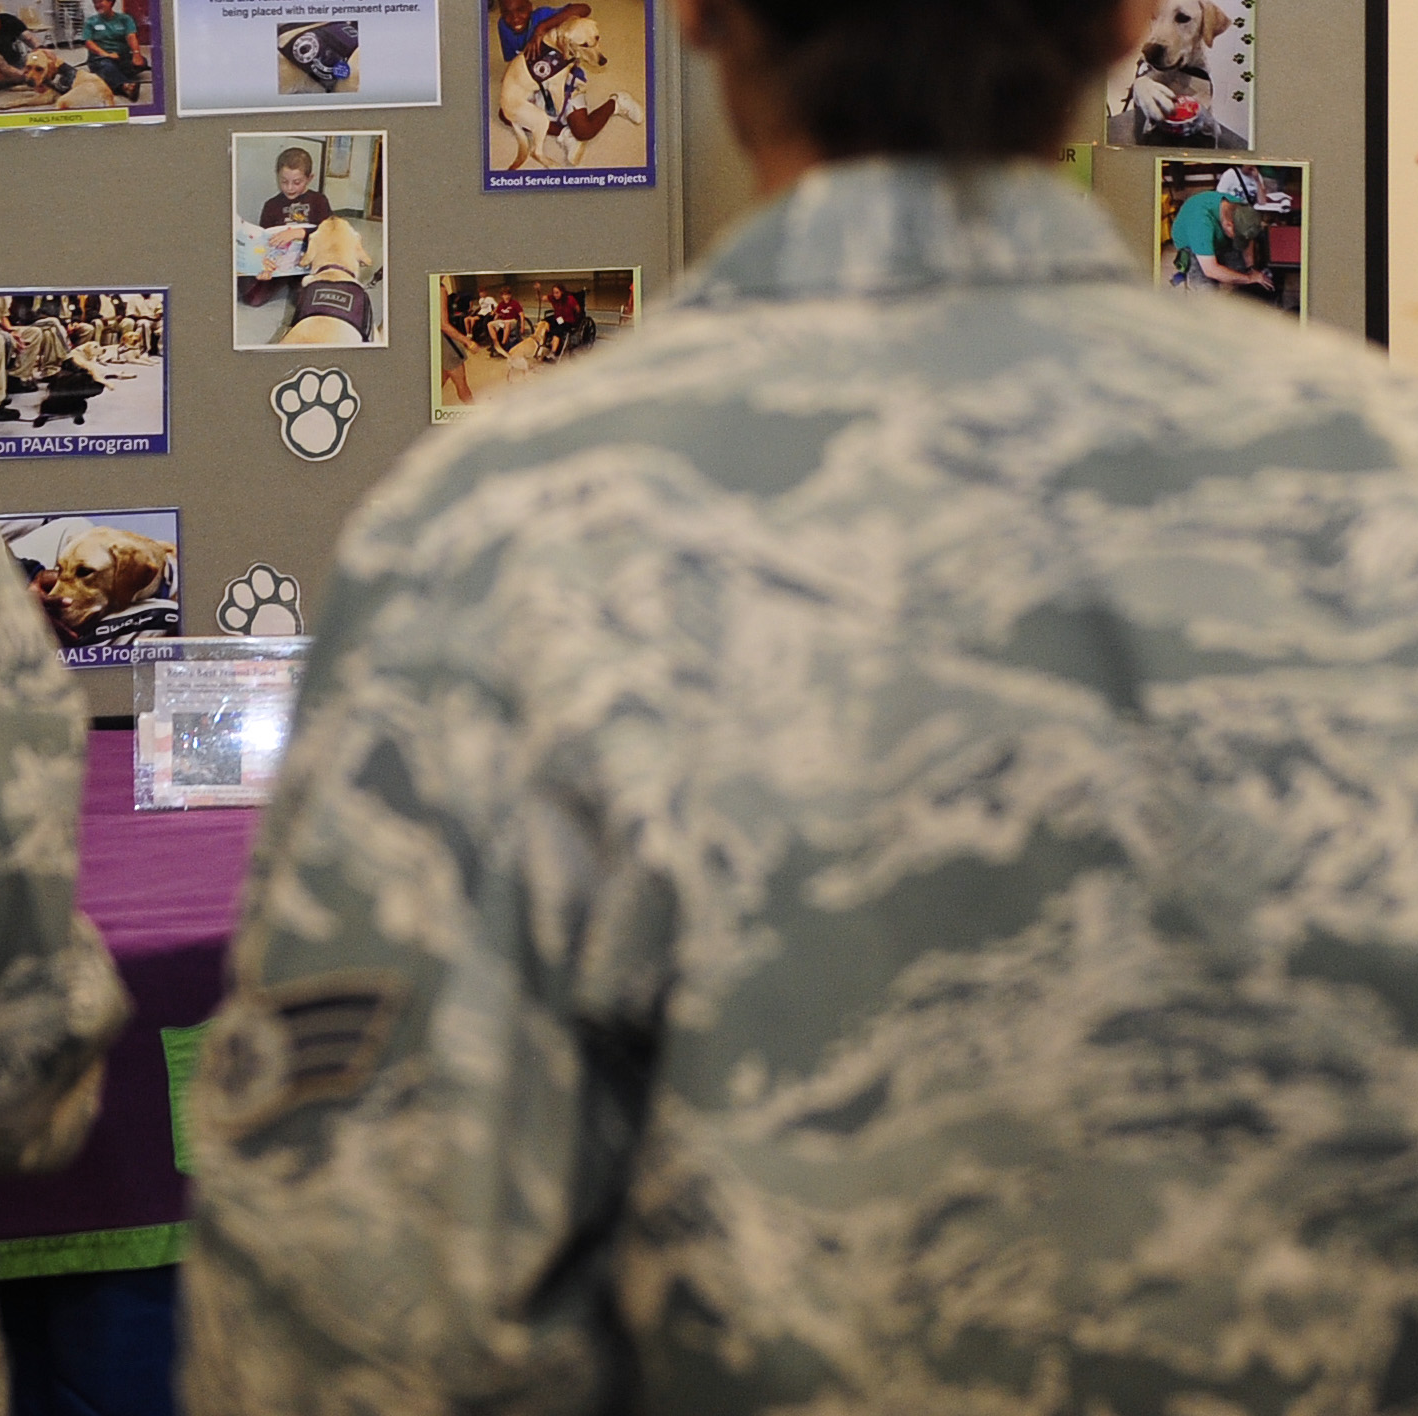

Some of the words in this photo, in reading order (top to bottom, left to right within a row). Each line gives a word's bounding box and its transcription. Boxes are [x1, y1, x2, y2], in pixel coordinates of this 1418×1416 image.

[222, 7, 249, 19] being
[251, 6, 283, 17] placed
[285, 5, 305, 15] with
[307, 4, 329, 14] their
[331, 4, 382, 16] permanent
[384, 3, 420, 14] partner.
[490, 176, 523, 186] School
[525, 175, 561, 186] Service
[563, 174, 605, 186] Learning
[607, 173, 647, 186] Projects
[21, 437, 74, 453] PAALS
[78, 437, 150, 455] Program
[56, 647, 97, 663] AALS
[102, 646, 173, 663] Program
